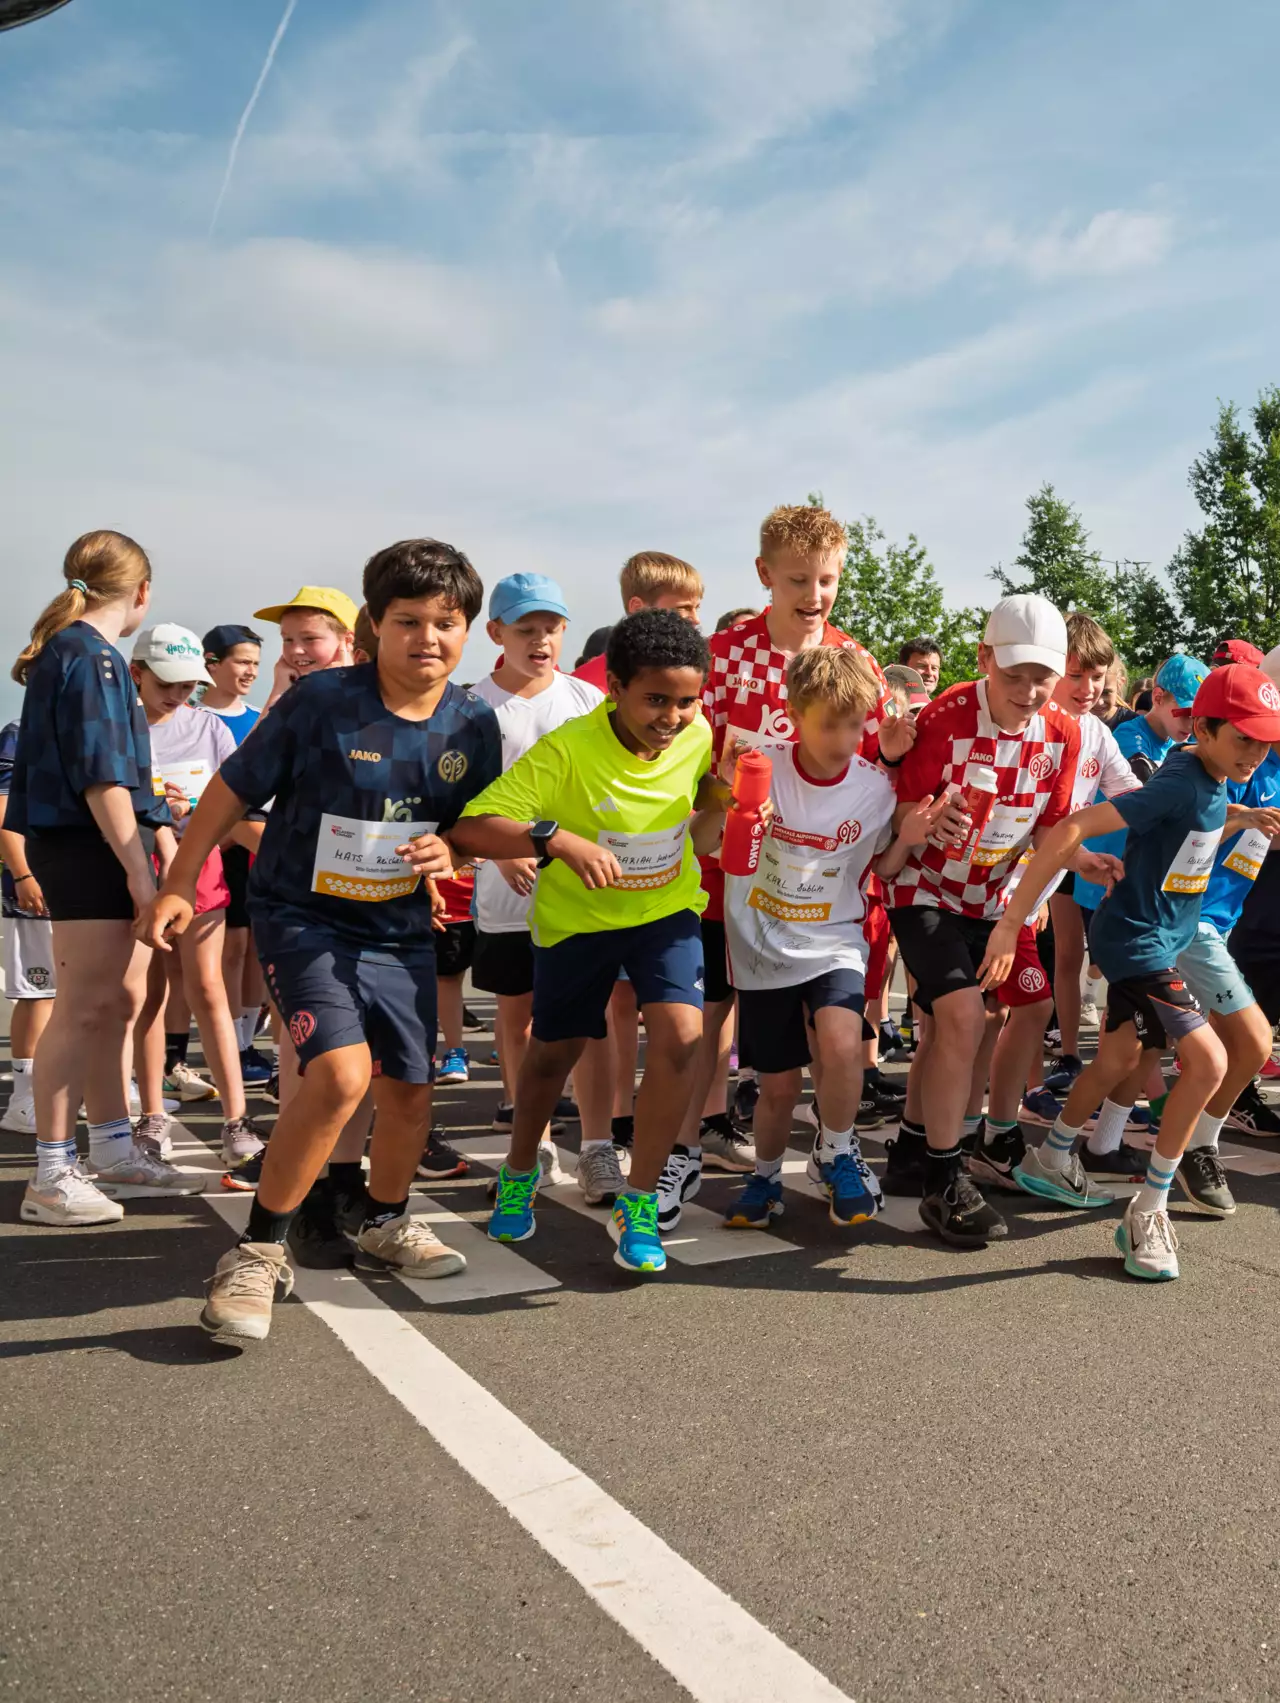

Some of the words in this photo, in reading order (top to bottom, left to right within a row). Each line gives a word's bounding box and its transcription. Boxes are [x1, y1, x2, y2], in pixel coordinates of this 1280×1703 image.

[731, 677, 759, 690] JAKO
[349, 749, 382, 763] JAKO
[969, 752, 994, 763] JAKO
[334, 849, 363, 863] MATS
[747, 837, 761, 869] JAKO
[765, 871, 789, 889] KARL
